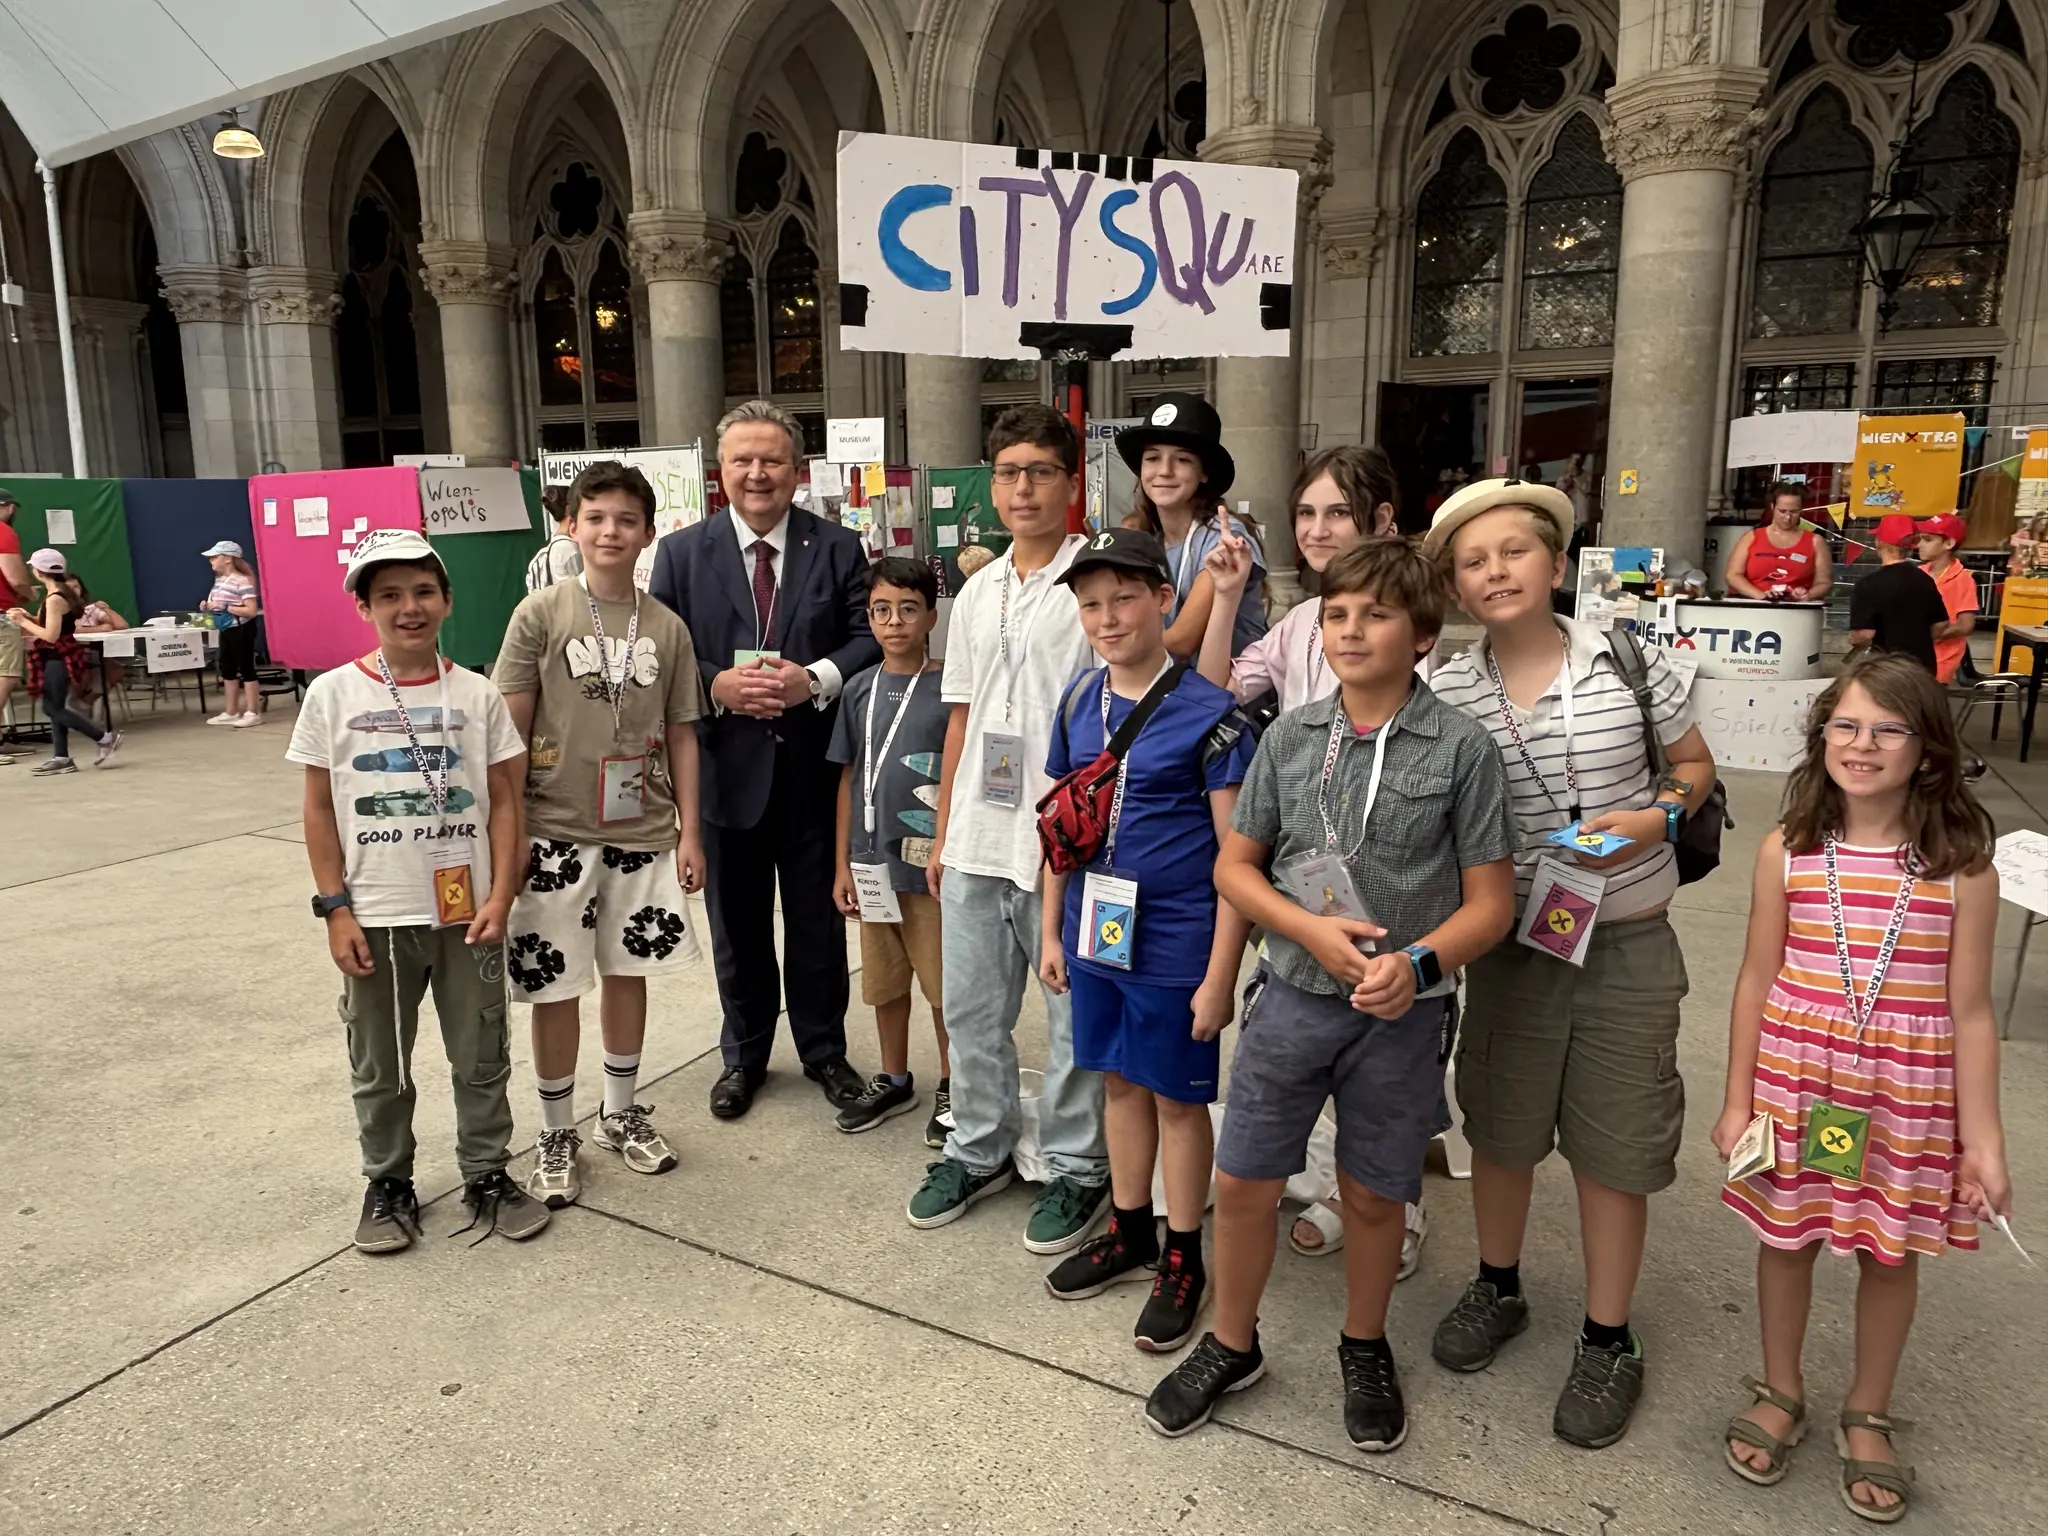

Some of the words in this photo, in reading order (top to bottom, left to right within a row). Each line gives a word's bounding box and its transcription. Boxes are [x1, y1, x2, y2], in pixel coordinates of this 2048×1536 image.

[427, 480, 480, 502] Wien-
[356, 828, 403, 846] GOOD
[413, 823, 478, 842] PLAYER
